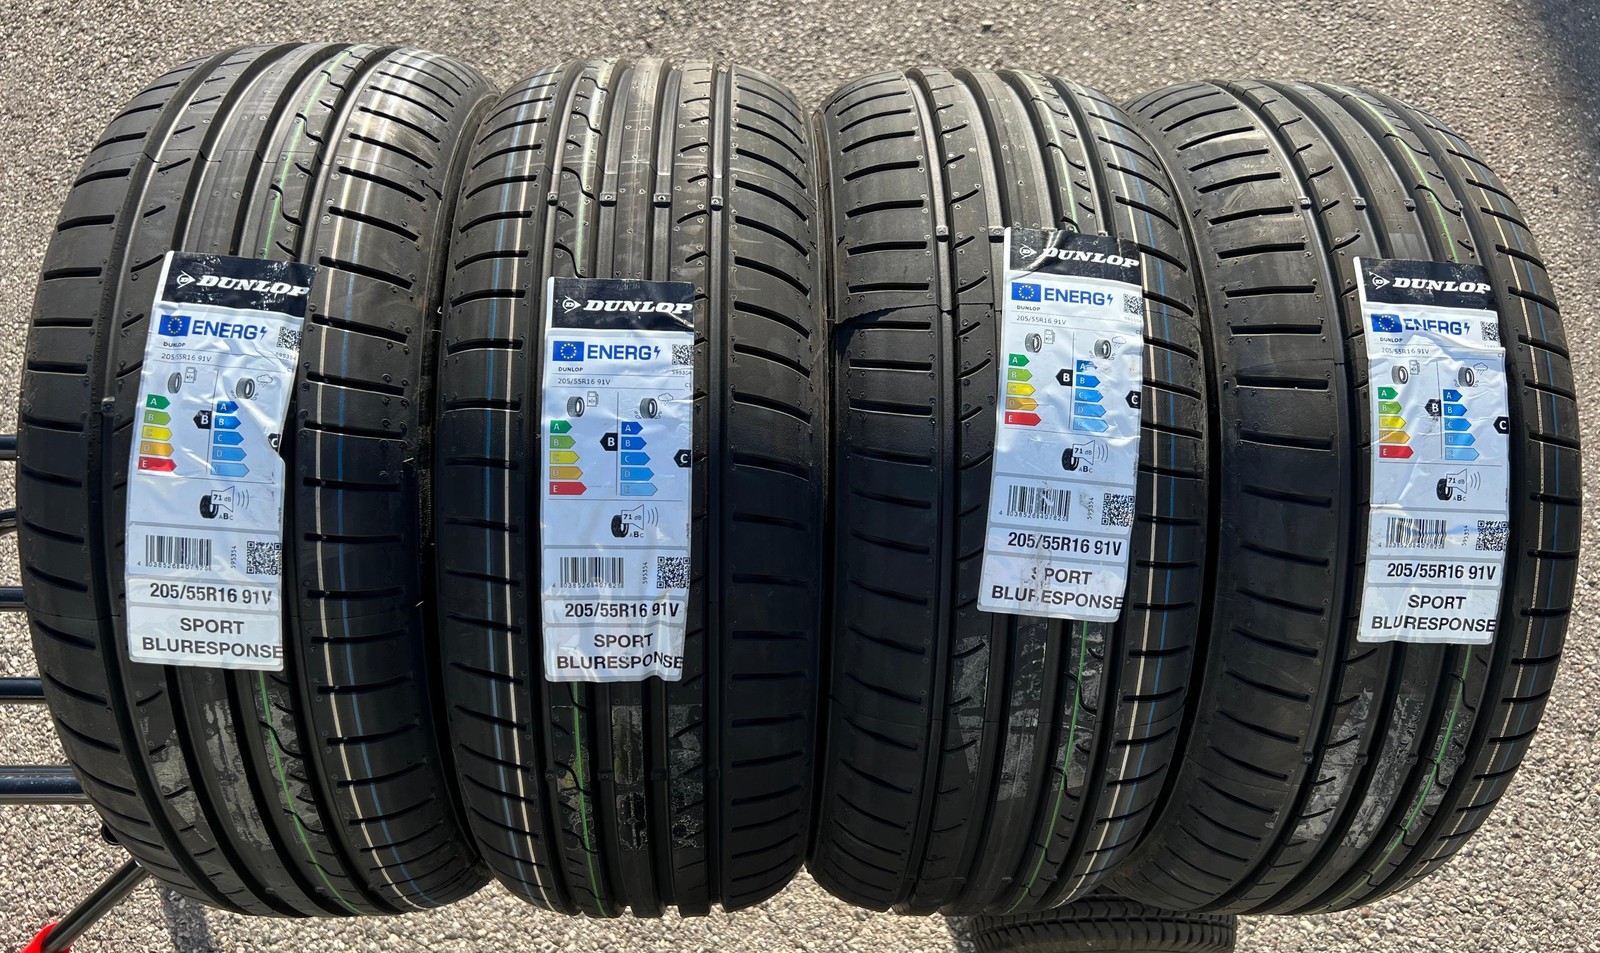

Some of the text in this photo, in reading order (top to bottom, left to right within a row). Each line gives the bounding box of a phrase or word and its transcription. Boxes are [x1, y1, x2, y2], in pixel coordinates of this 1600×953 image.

[1043, 247, 1139, 268] DUNLOP
[196, 275, 309, 296] DUNLOP
[1393, 278, 1491, 294] DUNLOP
[1044, 288, 1105, 306] ENERG
[584, 300, 692, 313] DUNLOP
[1016, 316, 1052, 324] 205/55R16
[191, 320, 257, 340] ENERG
[587, 345, 651, 360] ENERG
[1063, 373, 1070, 381] B
[1131, 395, 1138, 403] C
[1432, 403, 1439, 412] B
[201, 416, 209, 424] B
[1499, 421, 1506, 429] C
[272, 439, 277, 448] C
[608, 438, 615, 446] B
[680, 454, 688, 463] C
[1008, 532, 1122, 556] 205/55R16 91V
[1387, 563, 1496, 580] 205/55R16 91V
[150, 583, 272, 605] 205/55R16 91V
[1408, 595, 1466, 609] SPORT
[565, 603, 679, 618] 205/55R16 91V
[180, 617, 244, 634] SPORT
[1372, 616, 1496, 632] BLURESPONSE
[143, 637, 283, 658] BLURESPONSE
[594, 633, 653, 648] SPORT
[557, 651, 684, 669] BLURESPONSE
